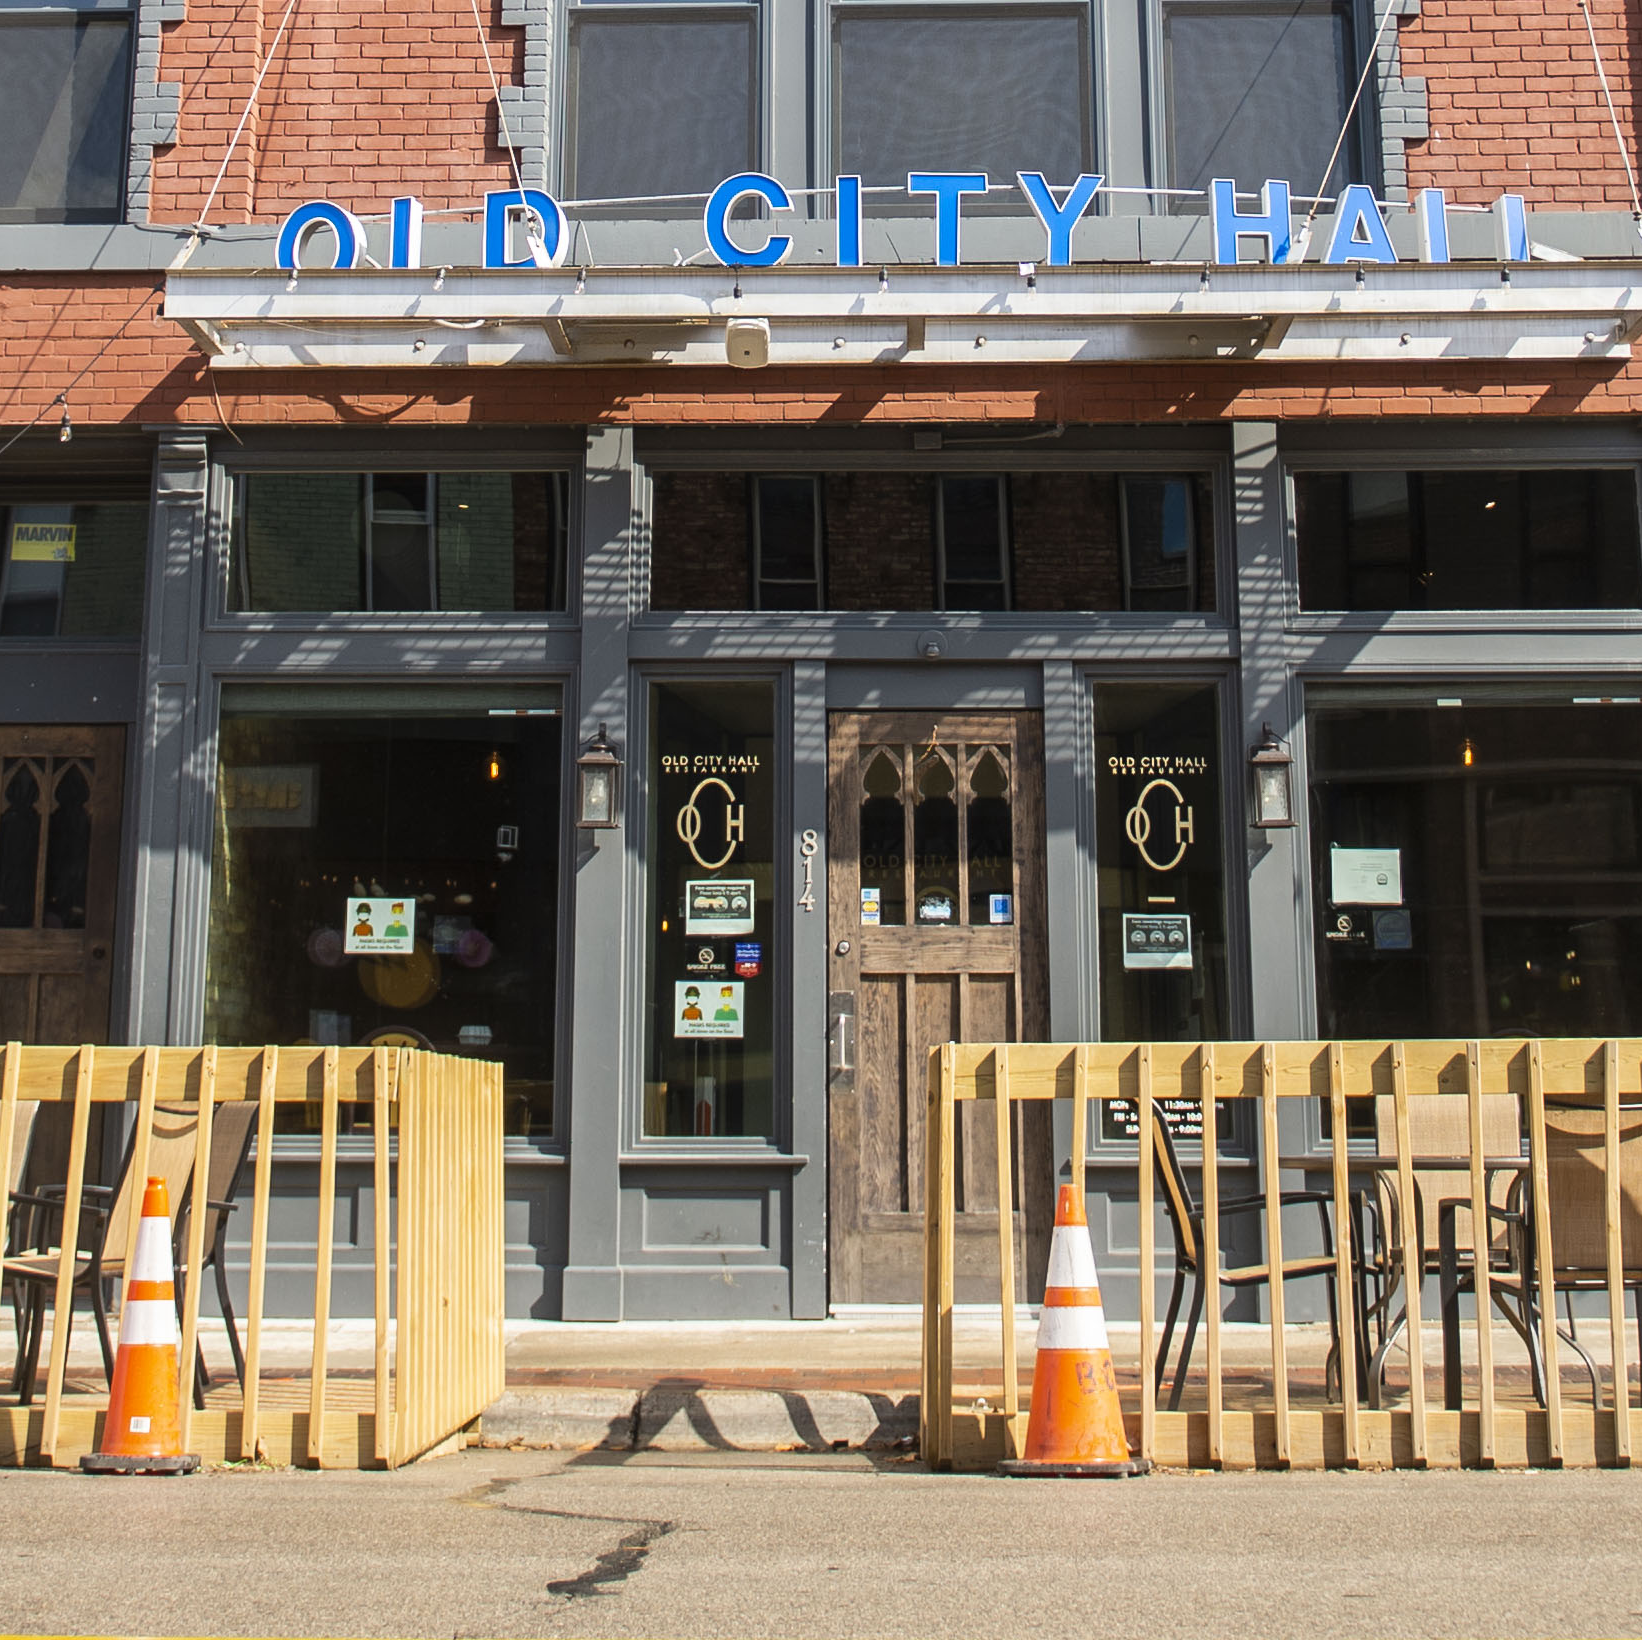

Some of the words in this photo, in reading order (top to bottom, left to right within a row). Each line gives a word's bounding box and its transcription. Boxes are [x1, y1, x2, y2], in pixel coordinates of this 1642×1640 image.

[703, 171, 1105, 267] CITY
[15, 526, 73, 542] MARVIN
[662, 755, 688, 766] OLD
[694, 755, 723, 766] CITY
[728, 755, 760, 766] HALL
[1108, 756, 1135, 767] OLD
[1141, 756, 1170, 767] CITY
[1175, 756, 1207, 767] HALL
[665, 766, 756, 774] RESTAURANT
[1112, 767, 1204, 775] RESTAURANT
[863, 855, 901, 868] OLD
[797, 828, 819, 912] 814
[1113, 1112, 1125, 1122] FRI
